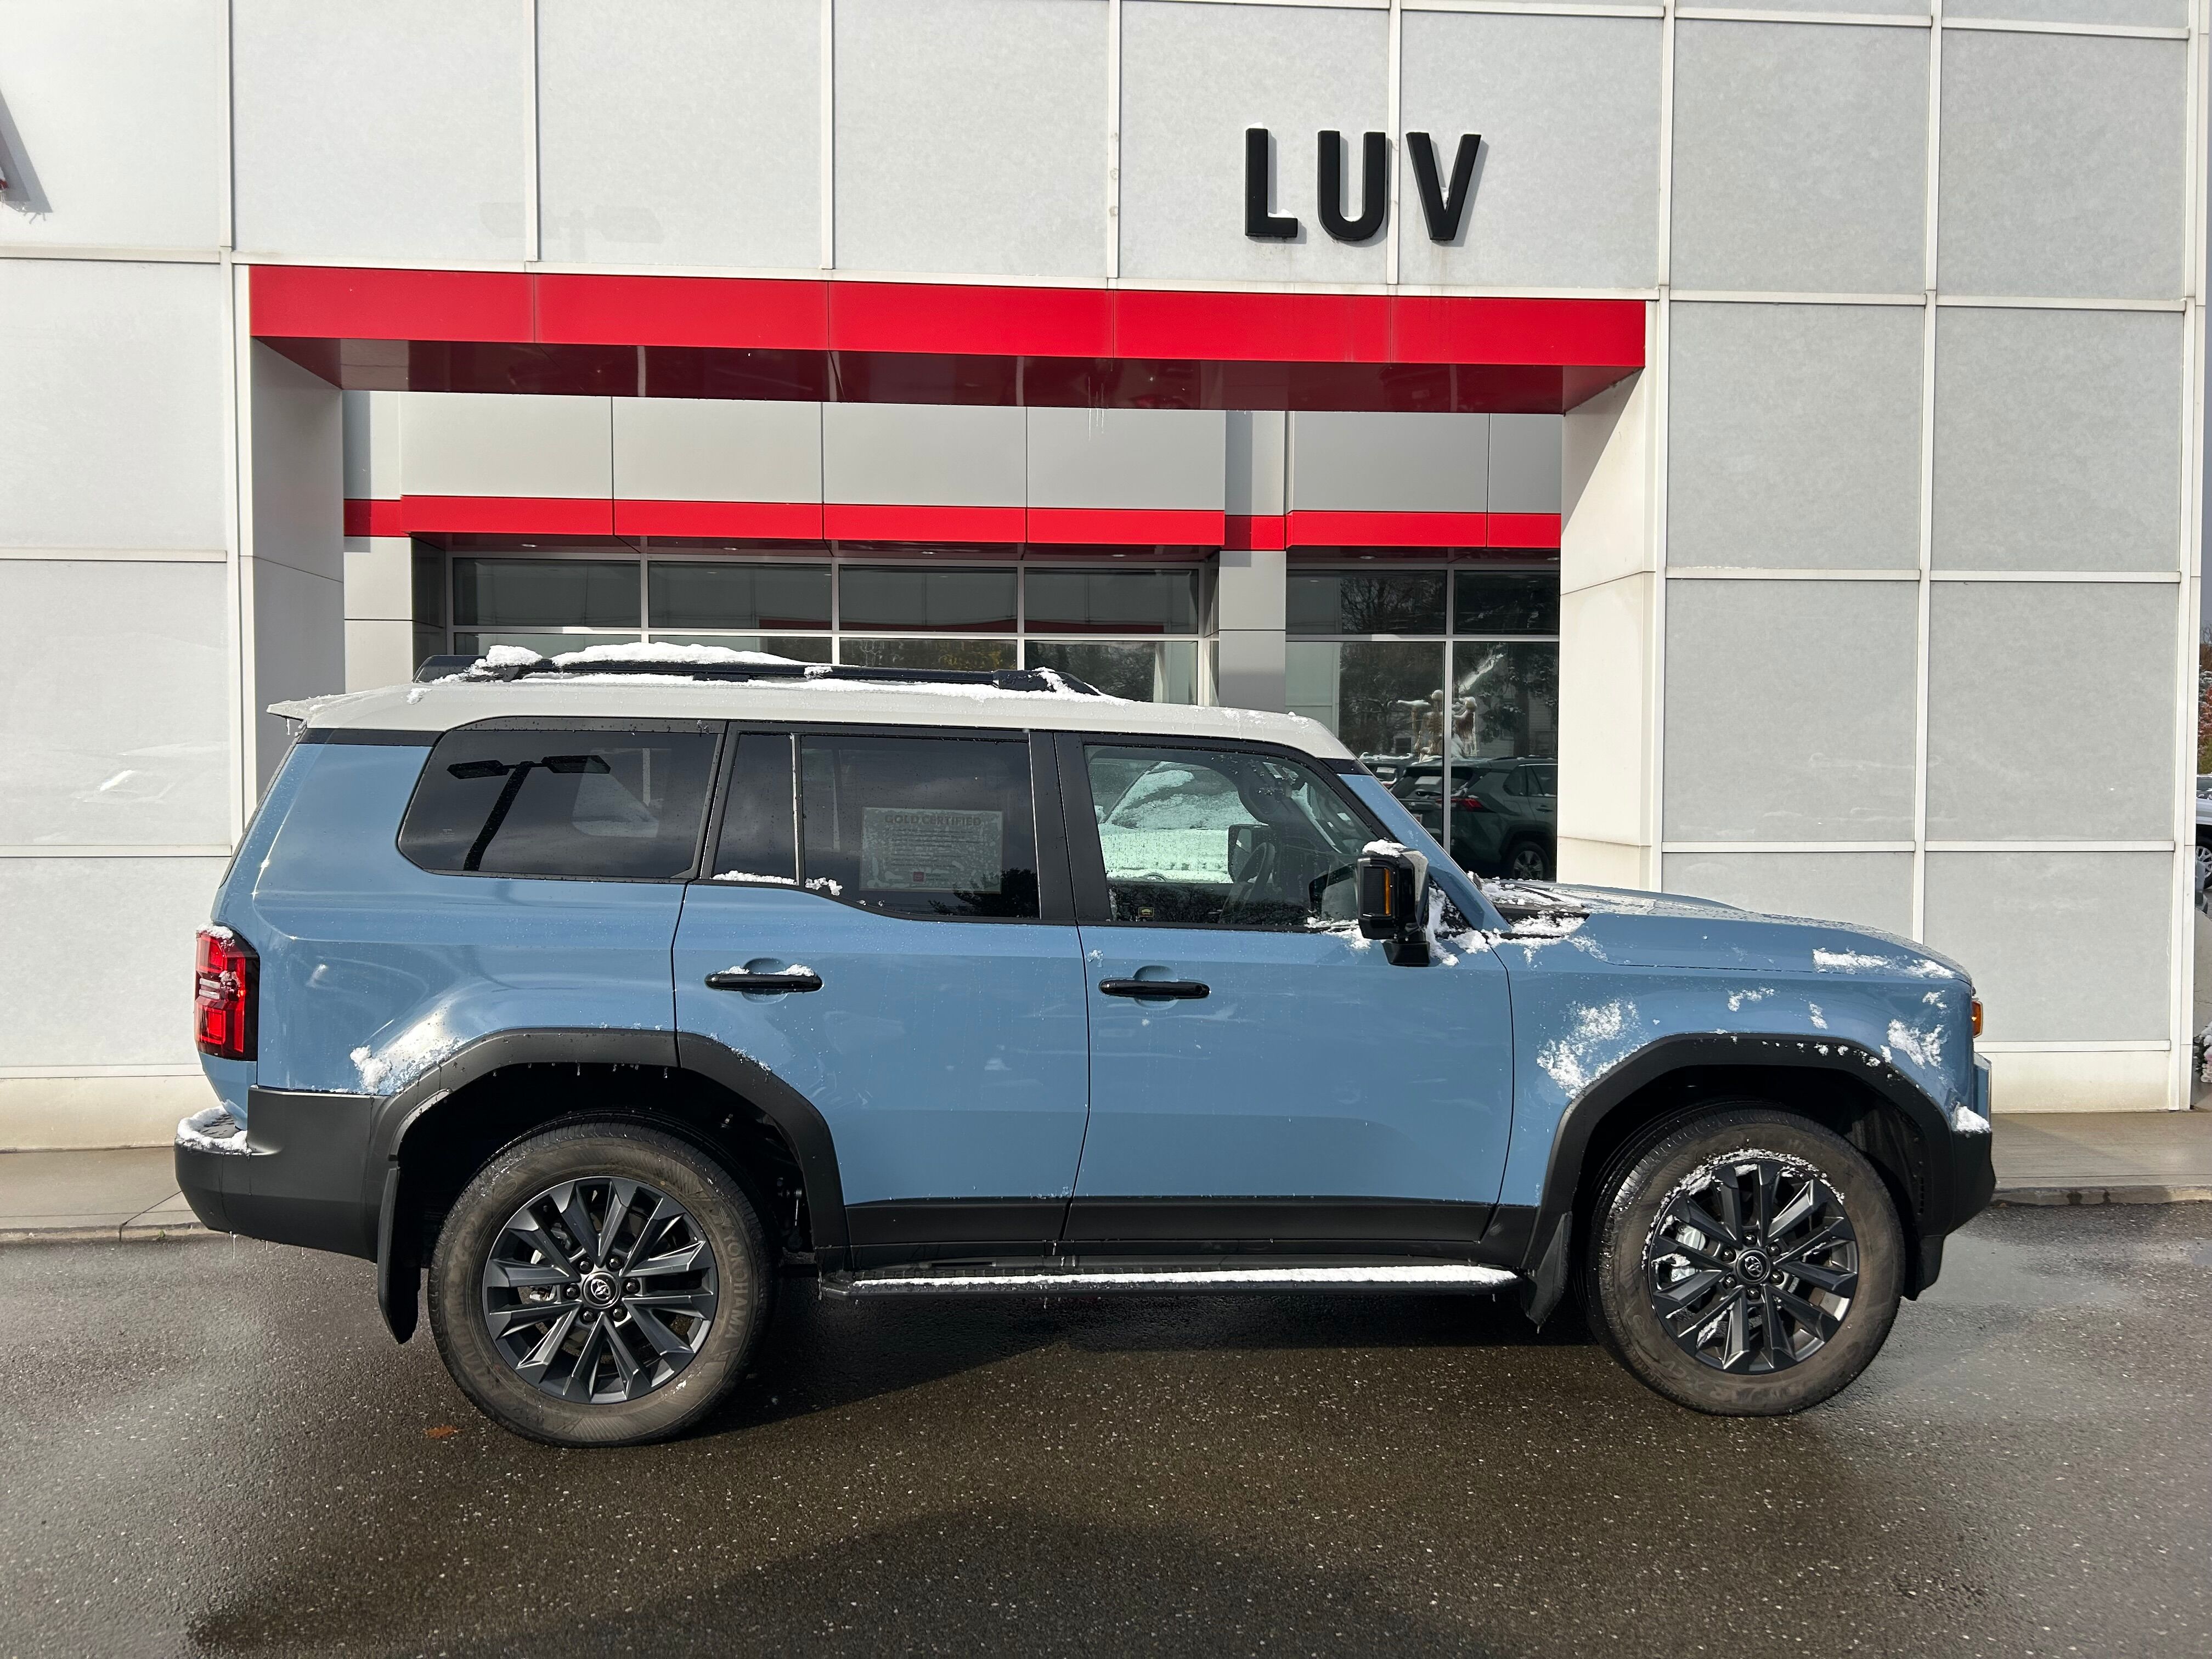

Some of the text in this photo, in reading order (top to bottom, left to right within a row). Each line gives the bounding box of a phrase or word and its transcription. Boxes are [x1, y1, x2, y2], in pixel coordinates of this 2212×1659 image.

[1245, 128, 1482, 241] LUV
[884, 814, 982, 826] GOLD CERTIFIED
[724, 1229, 748, 1339] YOKOHAMA
